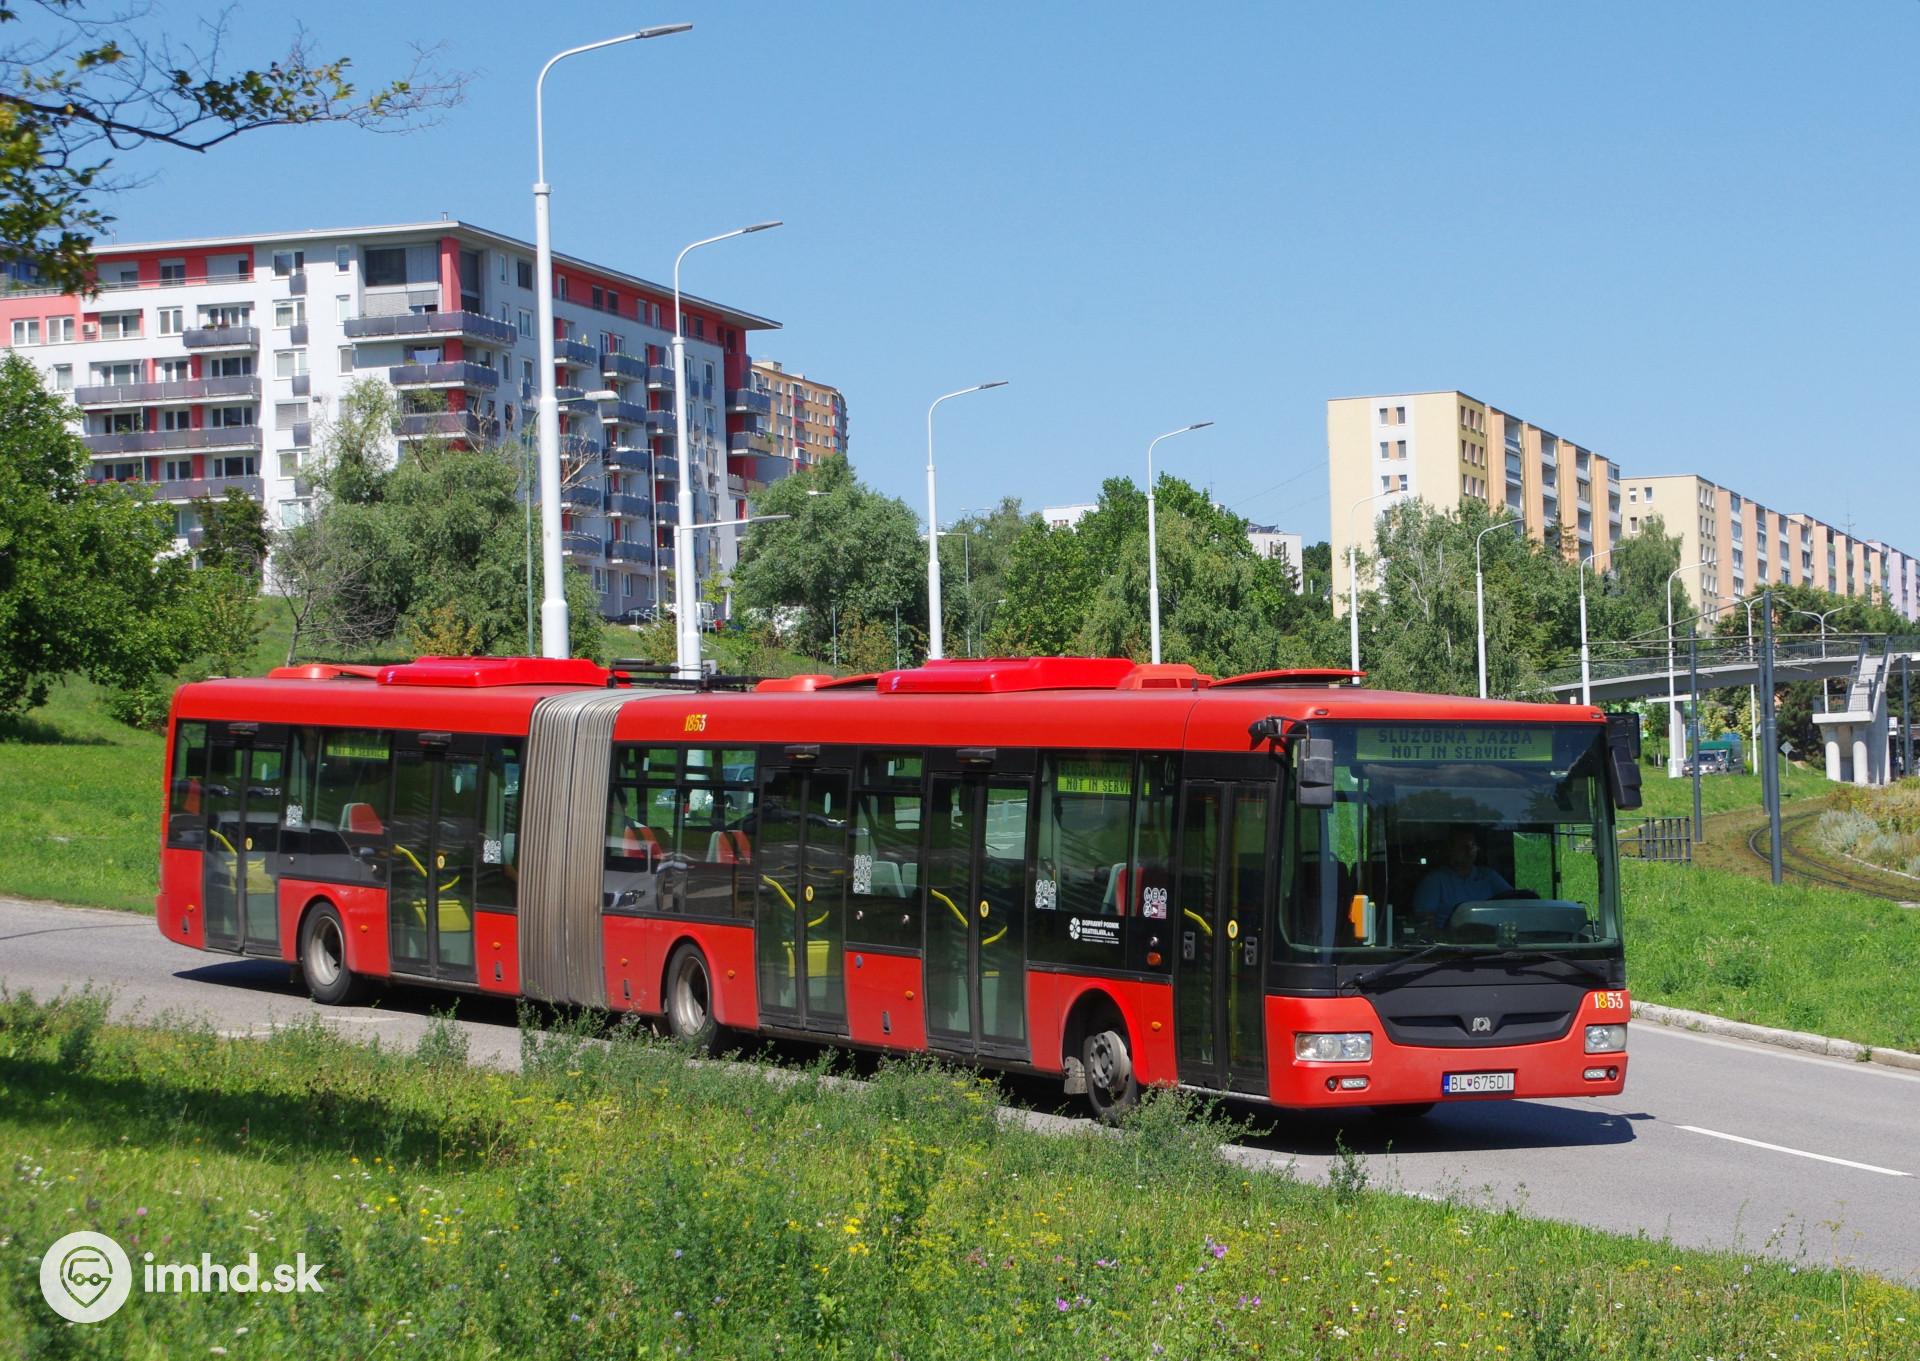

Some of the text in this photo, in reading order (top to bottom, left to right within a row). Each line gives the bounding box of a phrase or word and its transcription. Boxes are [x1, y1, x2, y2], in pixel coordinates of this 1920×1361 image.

[684, 713, 708, 732] 1853
[1476, 729, 1533, 745] JAZDA
[1391, 745, 1518, 760] NOT IN SERVICE
[1593, 992, 1624, 1009] 1853
